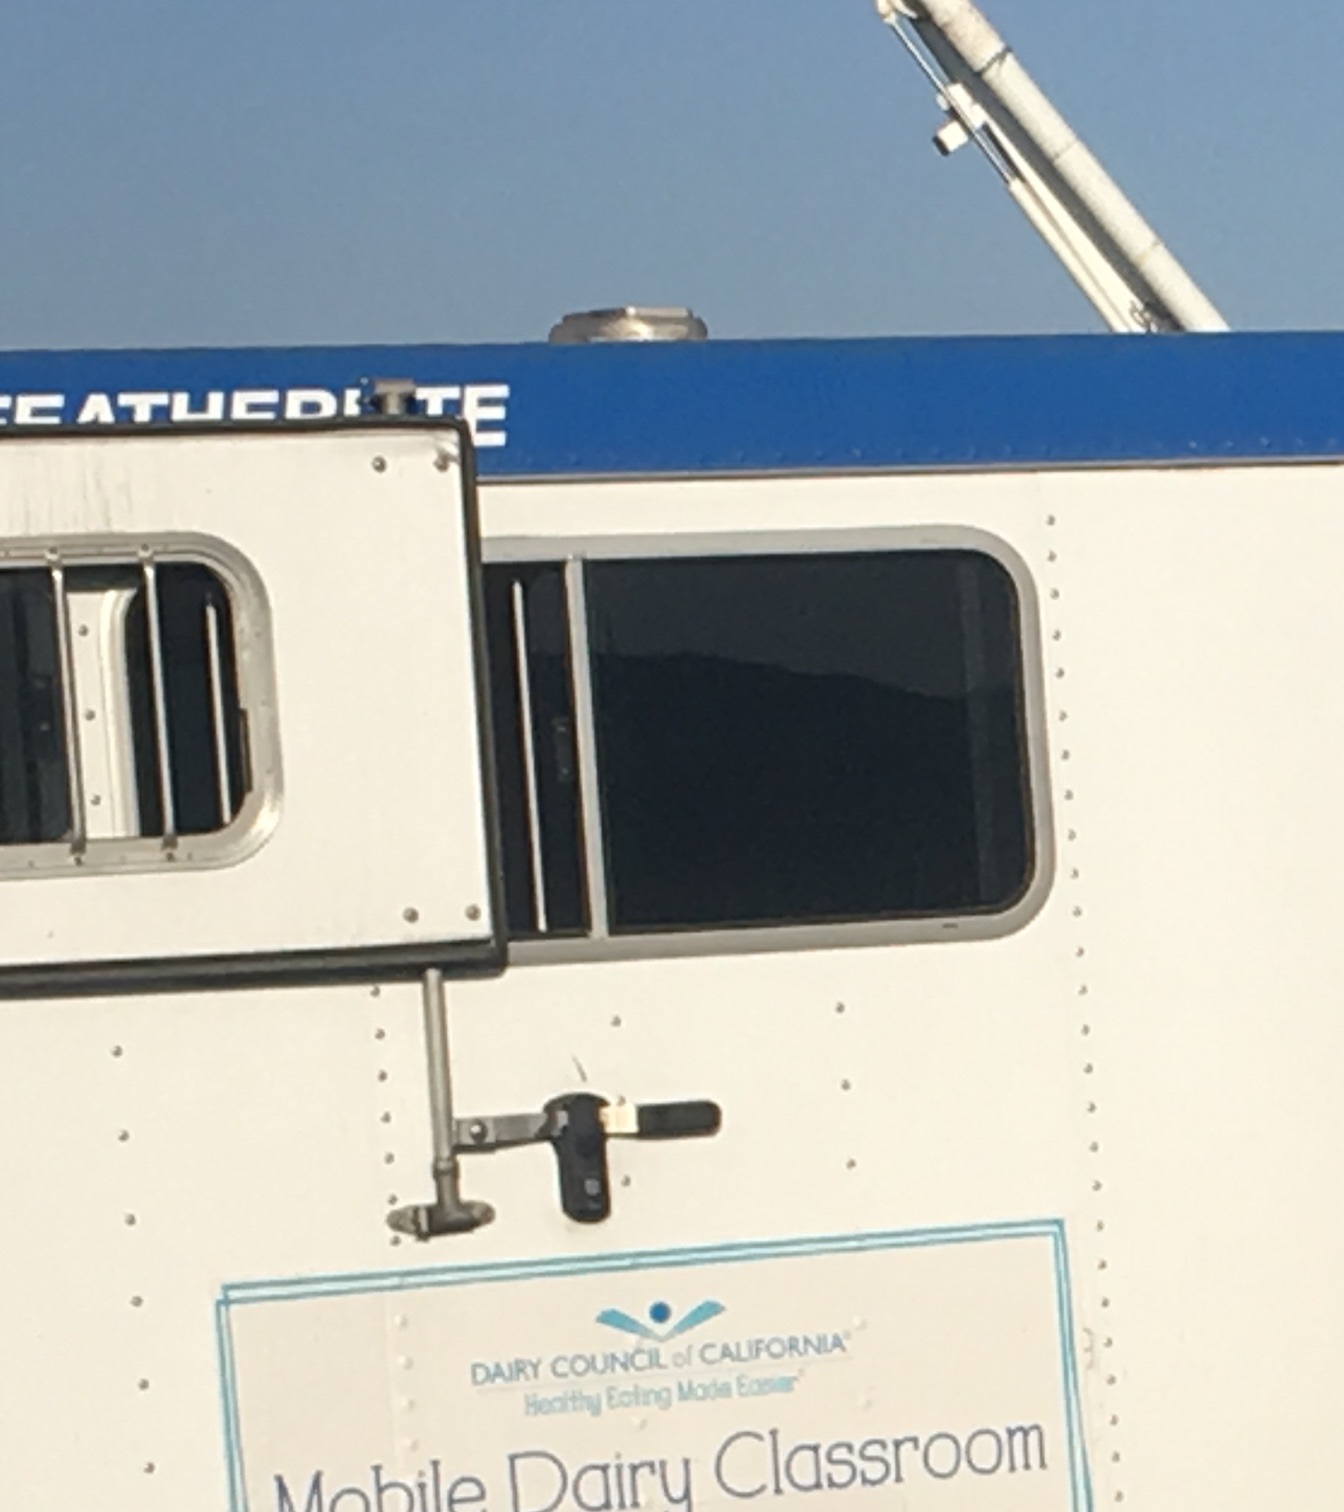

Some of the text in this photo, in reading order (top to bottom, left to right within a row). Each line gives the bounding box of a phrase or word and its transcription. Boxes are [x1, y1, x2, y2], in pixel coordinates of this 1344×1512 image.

[0, 384, 510, 447] EATHERTE
[470, 1332, 847, 1386] DAIRY COUNCIL of CALIFORNIA
[715, 1423, 1048, 1499] Classroom
